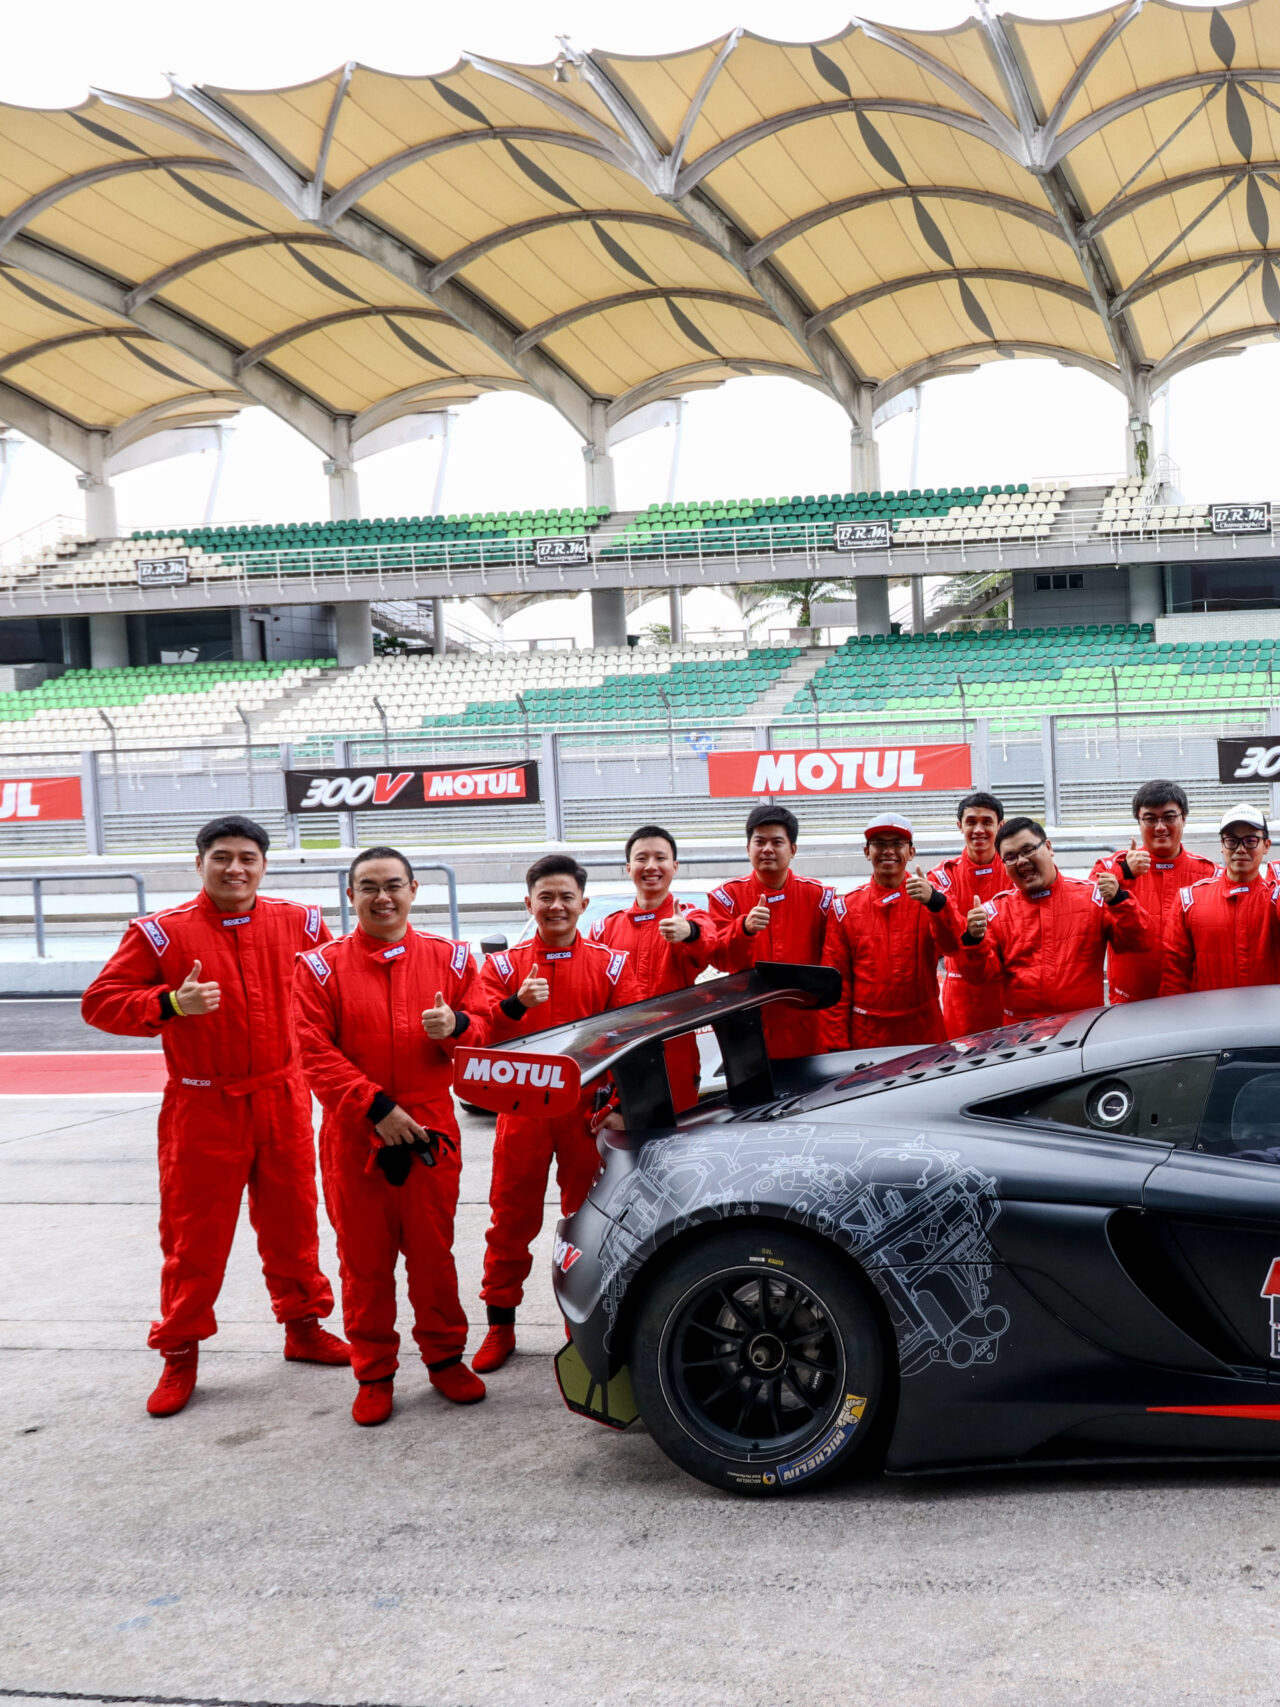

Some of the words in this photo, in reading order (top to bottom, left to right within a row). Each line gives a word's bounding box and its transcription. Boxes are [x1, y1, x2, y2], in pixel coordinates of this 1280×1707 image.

[1215, 509, 1264, 521] B.R.M
[839, 526, 887, 539] B.R.M
[539, 542, 585, 555] B.R.M
[752, 750, 924, 792] MOTUL
[301, 772, 415, 807] 300V
[428, 772, 521, 797] MOTUL
[223, 916, 251, 926] sparco
[143, 920, 165, 946] sparco
[383, 946, 406, 959] sparco
[546, 952, 572, 960] sparco
[307, 953, 327, 976] sparco
[463, 1057, 566, 1089] MOTUL
[182, 1078, 211, 1086] sparco
[783, 1429, 846, 1481] MICHELIN
